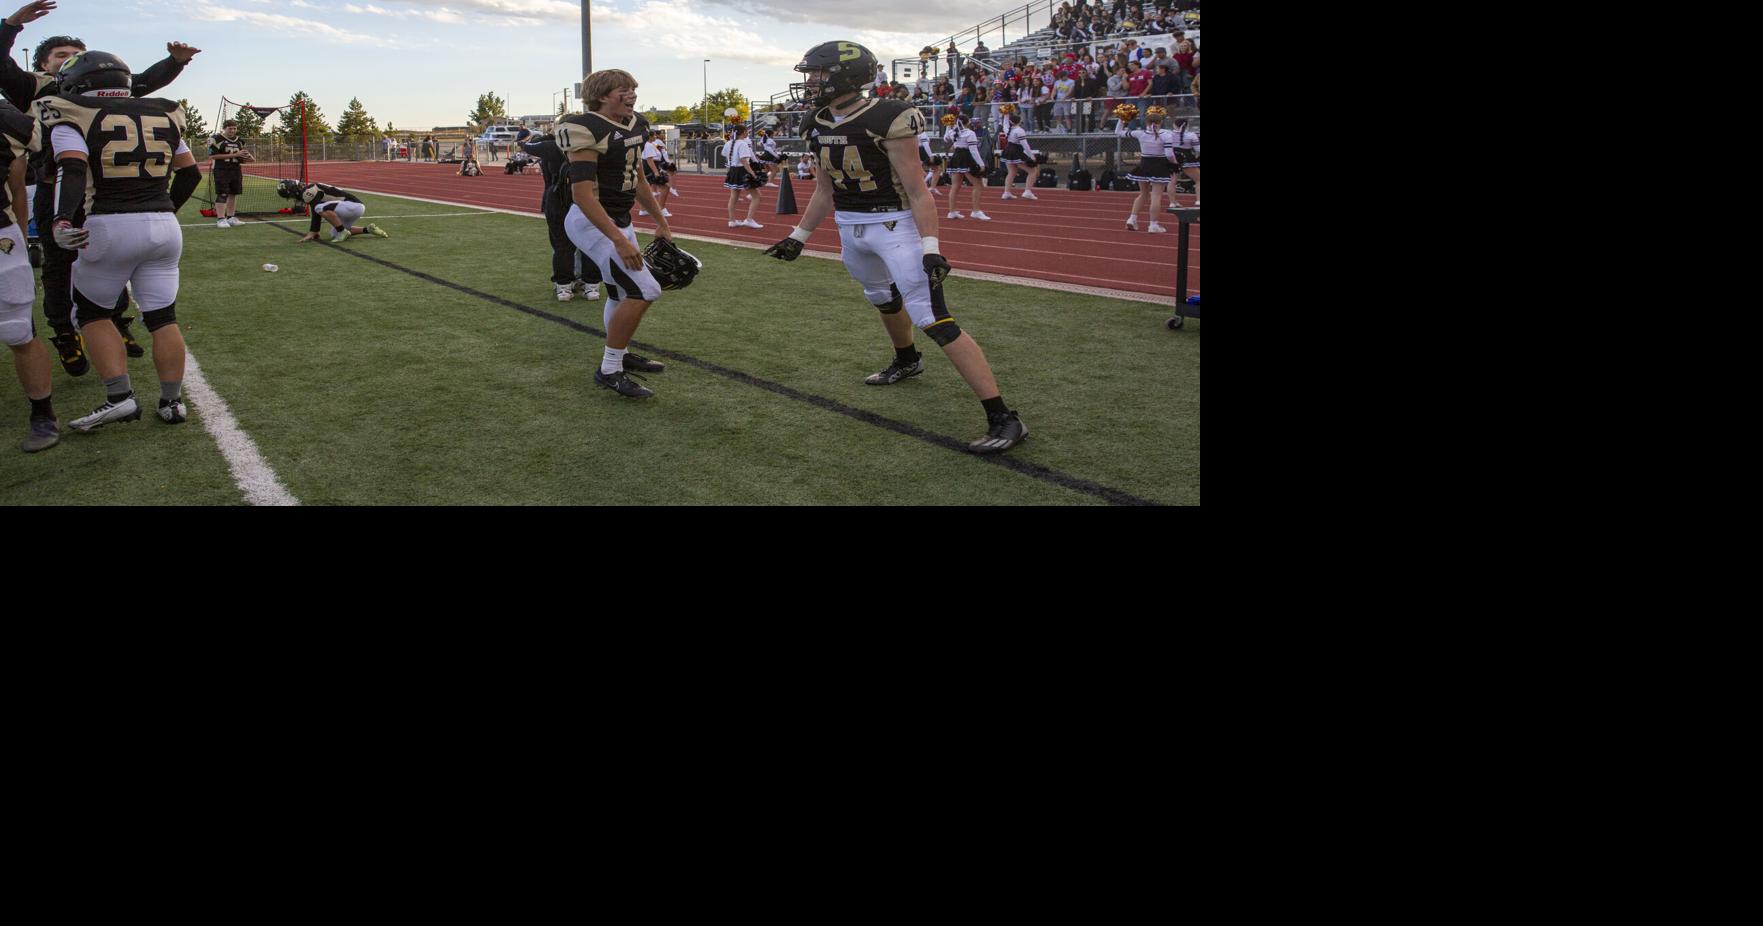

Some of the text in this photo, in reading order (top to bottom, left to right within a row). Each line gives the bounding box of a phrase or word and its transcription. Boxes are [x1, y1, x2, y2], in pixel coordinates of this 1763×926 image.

[37, 101, 61, 120] 25
[101, 114, 172, 178] 25
[559, 128, 571, 147] 11
[820, 145, 878, 192] 44
